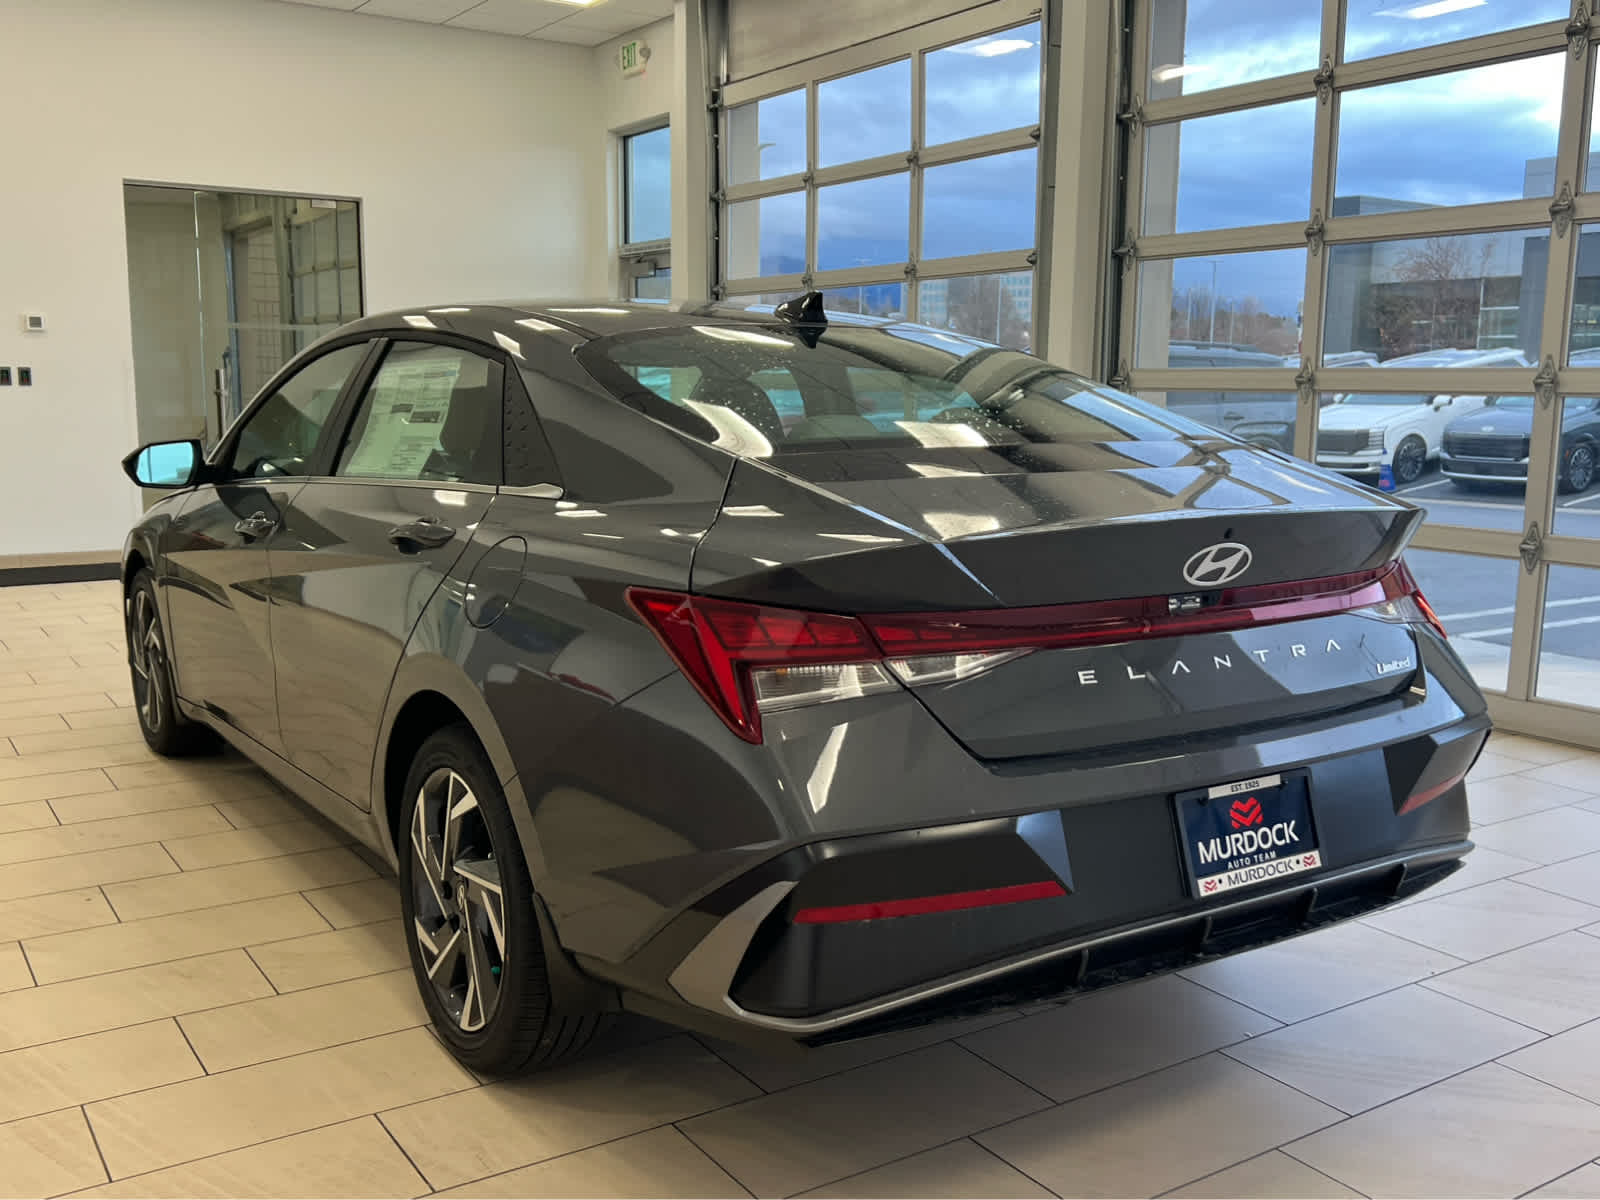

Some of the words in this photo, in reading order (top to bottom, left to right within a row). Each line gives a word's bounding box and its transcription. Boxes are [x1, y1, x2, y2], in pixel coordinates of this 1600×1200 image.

[622, 42, 637, 70] EXIT
[1077, 639, 1342, 685] ELANTRA
[1376, 656, 1410, 674] Limited
[1197, 820, 1299, 864] MURDOCK
[1227, 859, 1294, 887] MURDOCK
[1228, 857, 1250, 869] AUTO
[1254, 851, 1276, 862] TEAM
